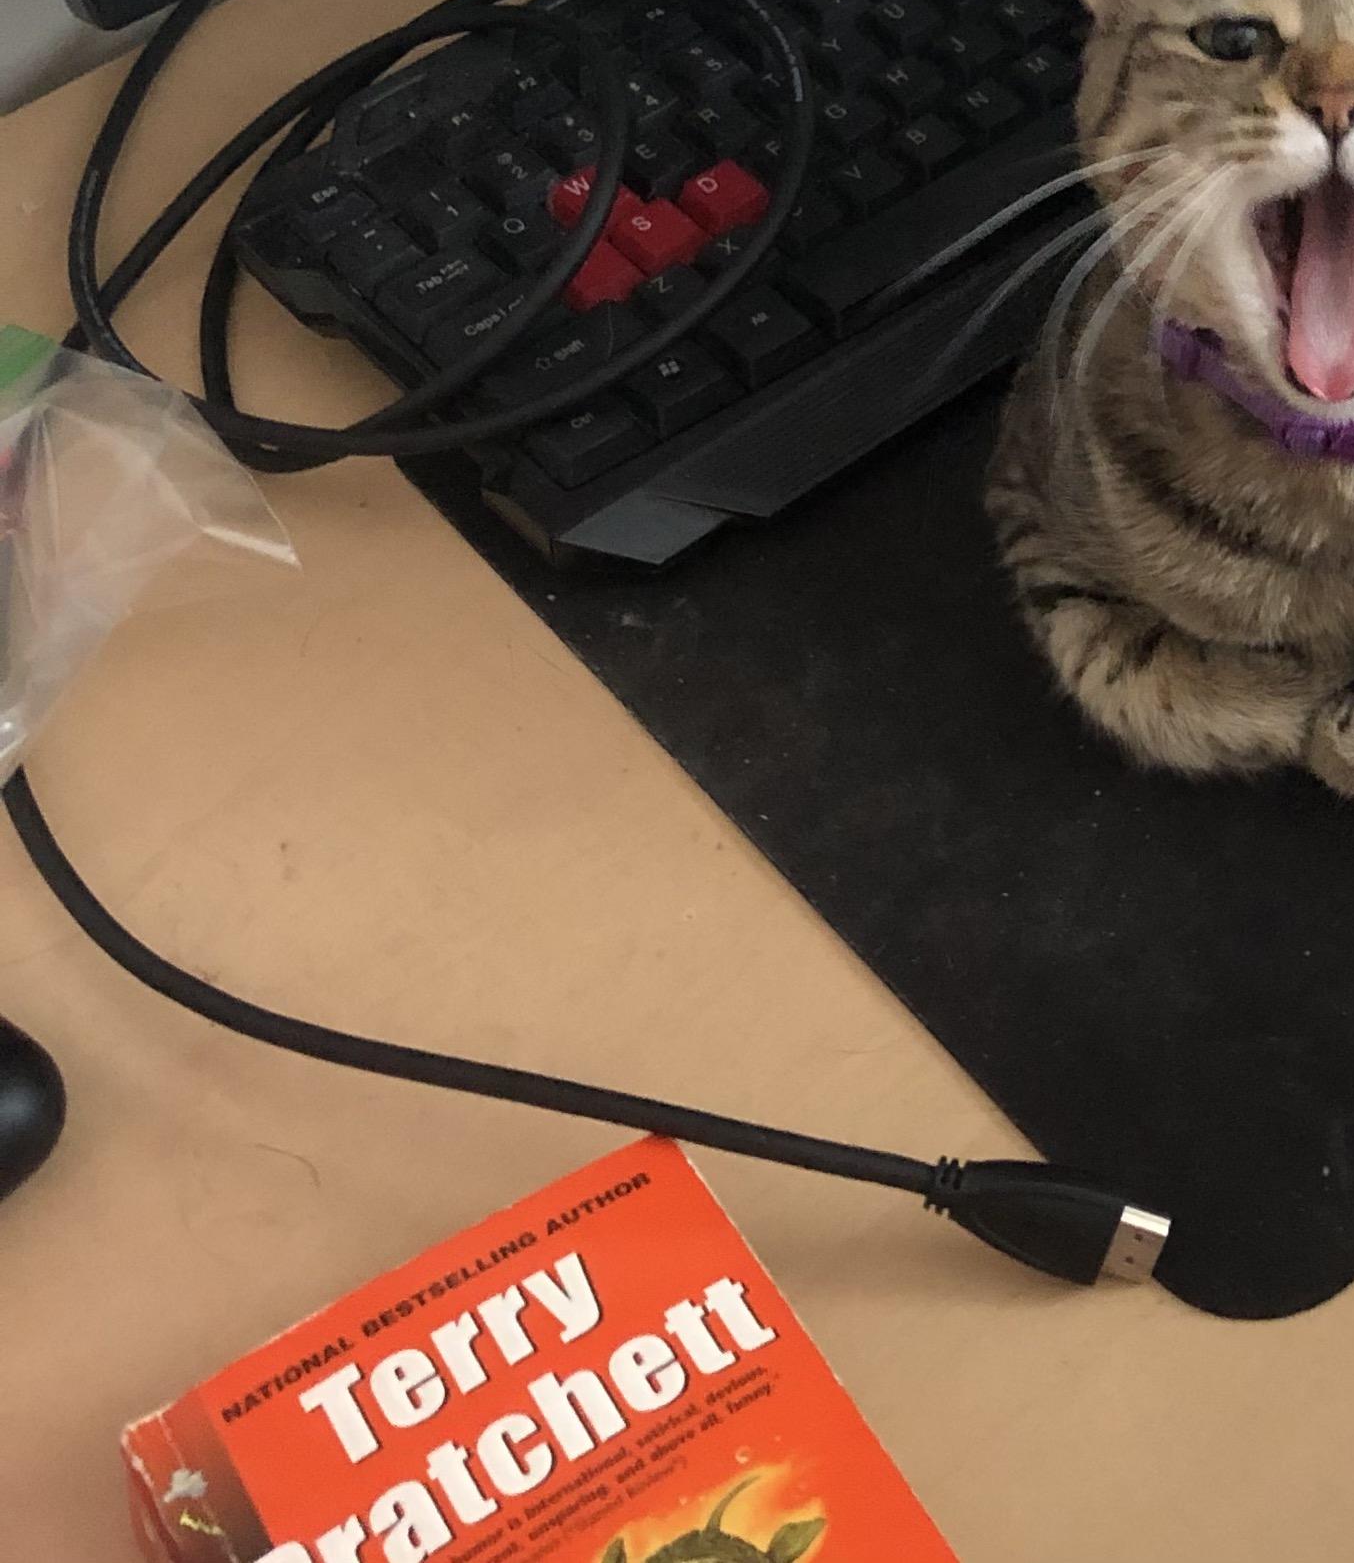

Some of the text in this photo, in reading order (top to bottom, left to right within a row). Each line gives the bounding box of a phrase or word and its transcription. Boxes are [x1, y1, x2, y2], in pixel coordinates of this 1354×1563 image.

[562, 176, 591, 197] W
[696, 176, 720, 195] D
[631, 215, 653, 232] S
[716, 237, 741, 256] X
[220, 1171, 653, 1424] NATIONAL BESTSELLING AUTHOR
[299, 1251, 603, 1465] Terry
[253, 1275, 778, 1563] ratchett
